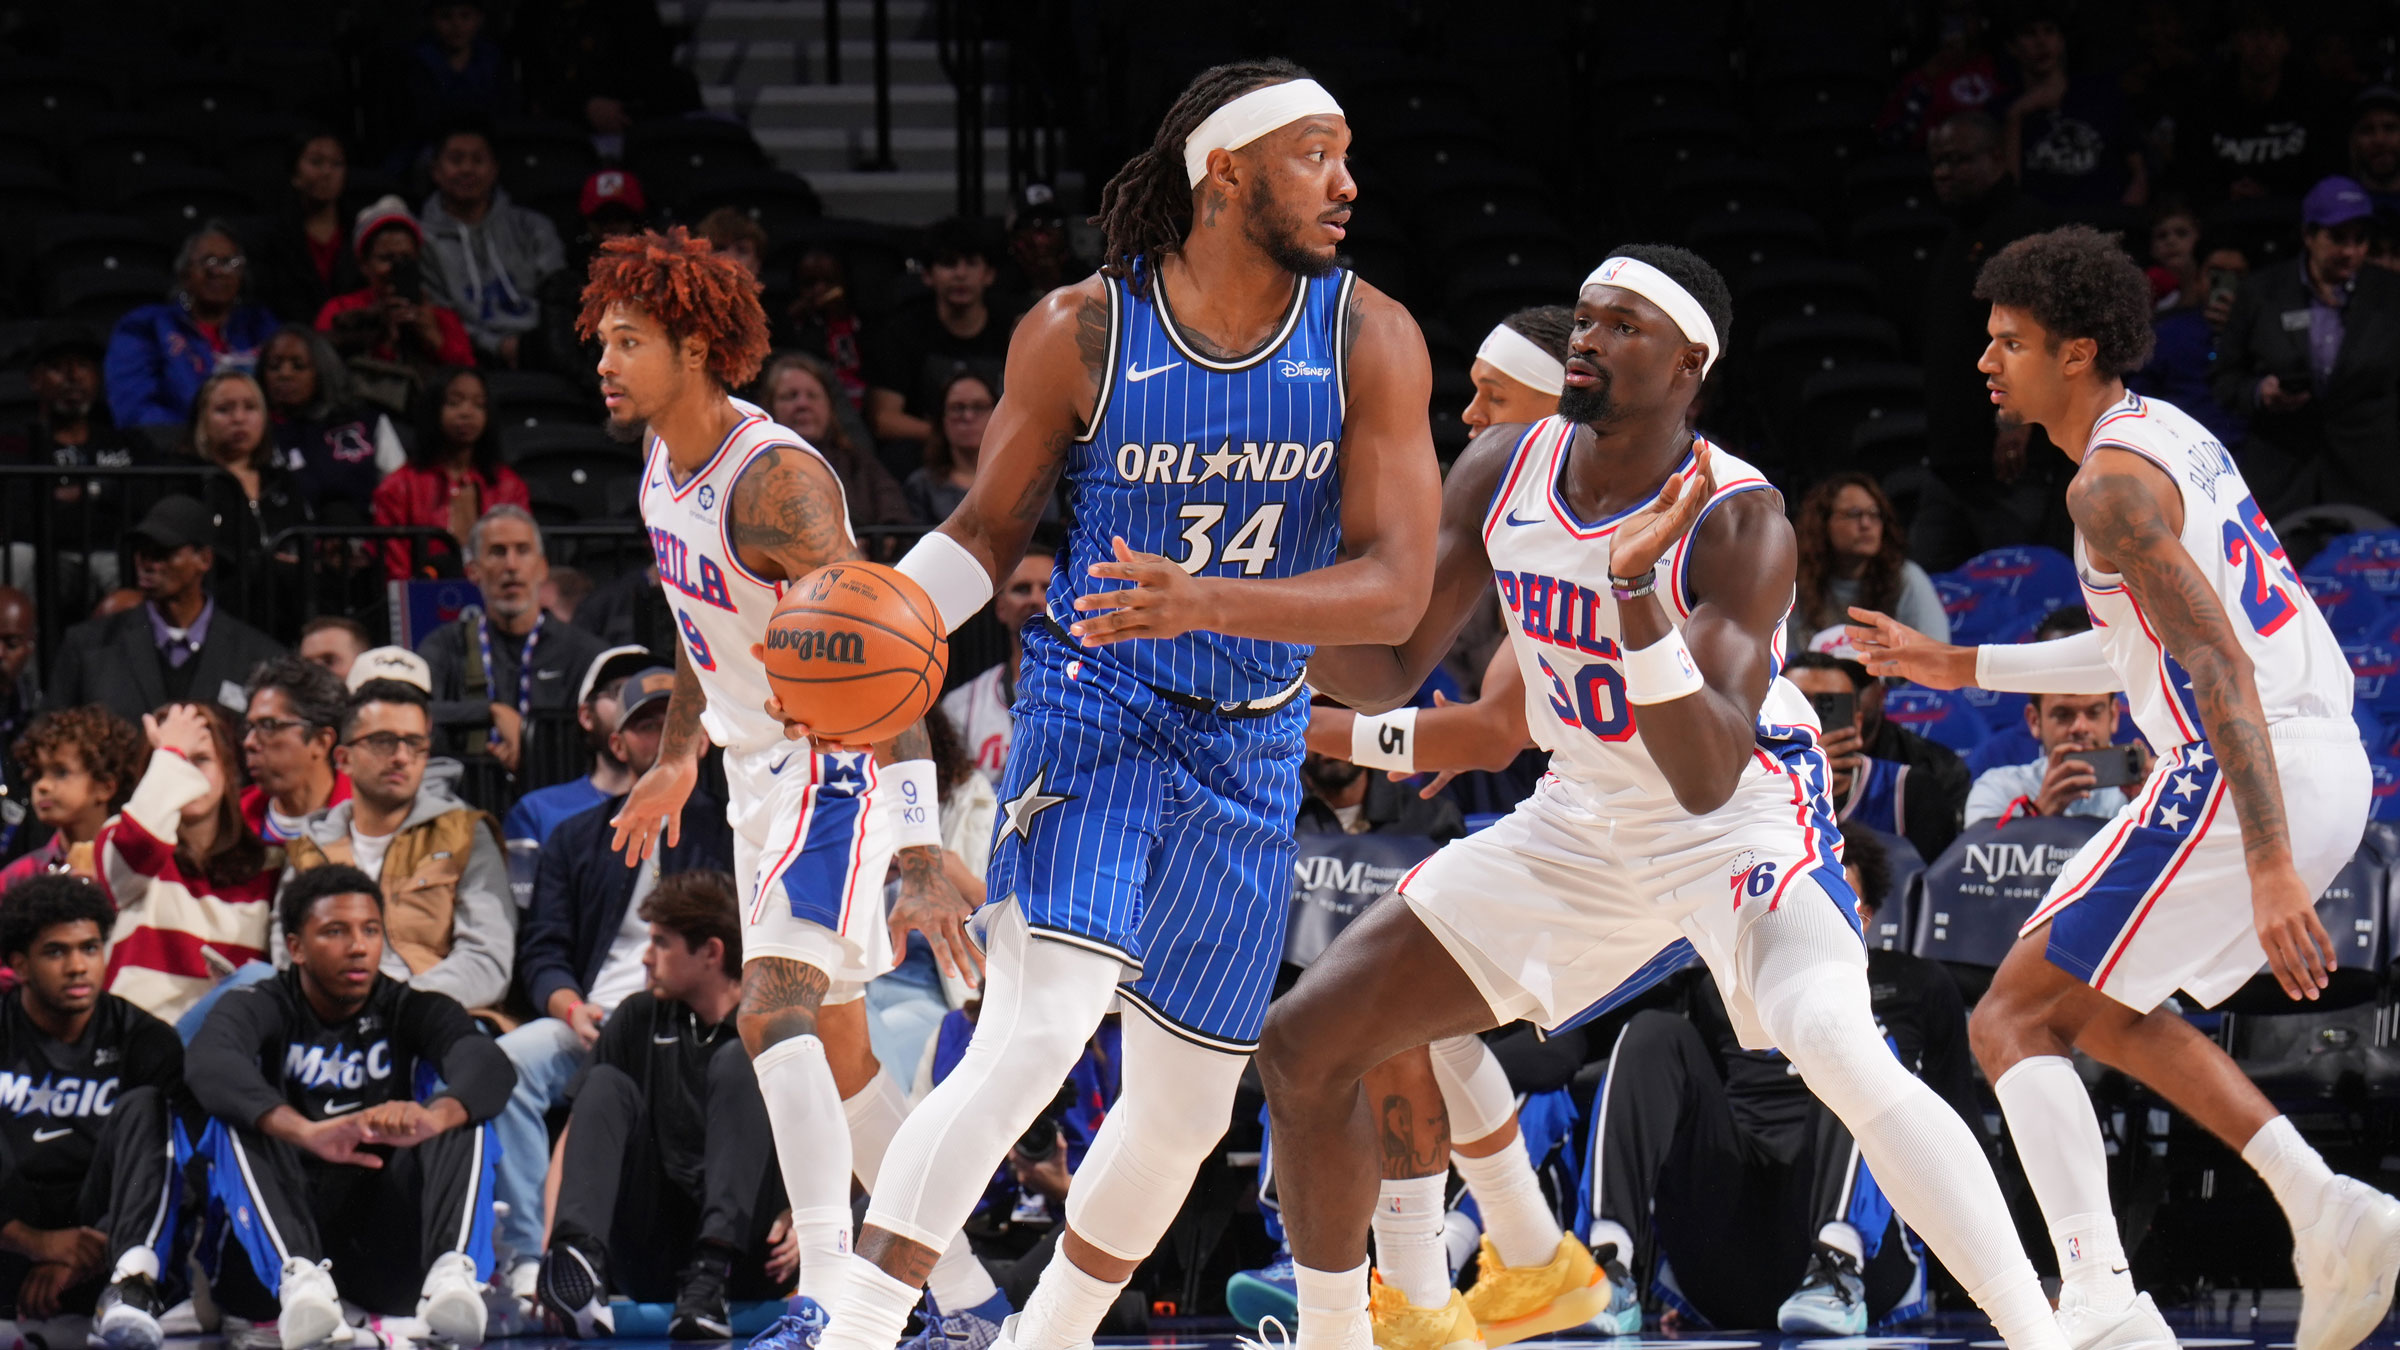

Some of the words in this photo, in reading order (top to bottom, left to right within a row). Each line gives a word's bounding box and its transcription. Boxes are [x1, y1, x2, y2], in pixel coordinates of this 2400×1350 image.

[1163, 502, 1287, 577] 34
[647, 525, 739, 614] HILA
[678, 607, 717, 673] 9
[1494, 568, 1624, 661] PHIL
[766, 628, 867, 665] Wilson
[1537, 652, 1638, 743] 30
[1378, 722, 1404, 755] 5
[902, 780, 917, 805] 9
[1293, 855, 1367, 895] NJM
[1729, 861, 1777, 914] 76
[1960, 843, 2048, 883] NJM
[284, 1038, 392, 1091] MAGC
